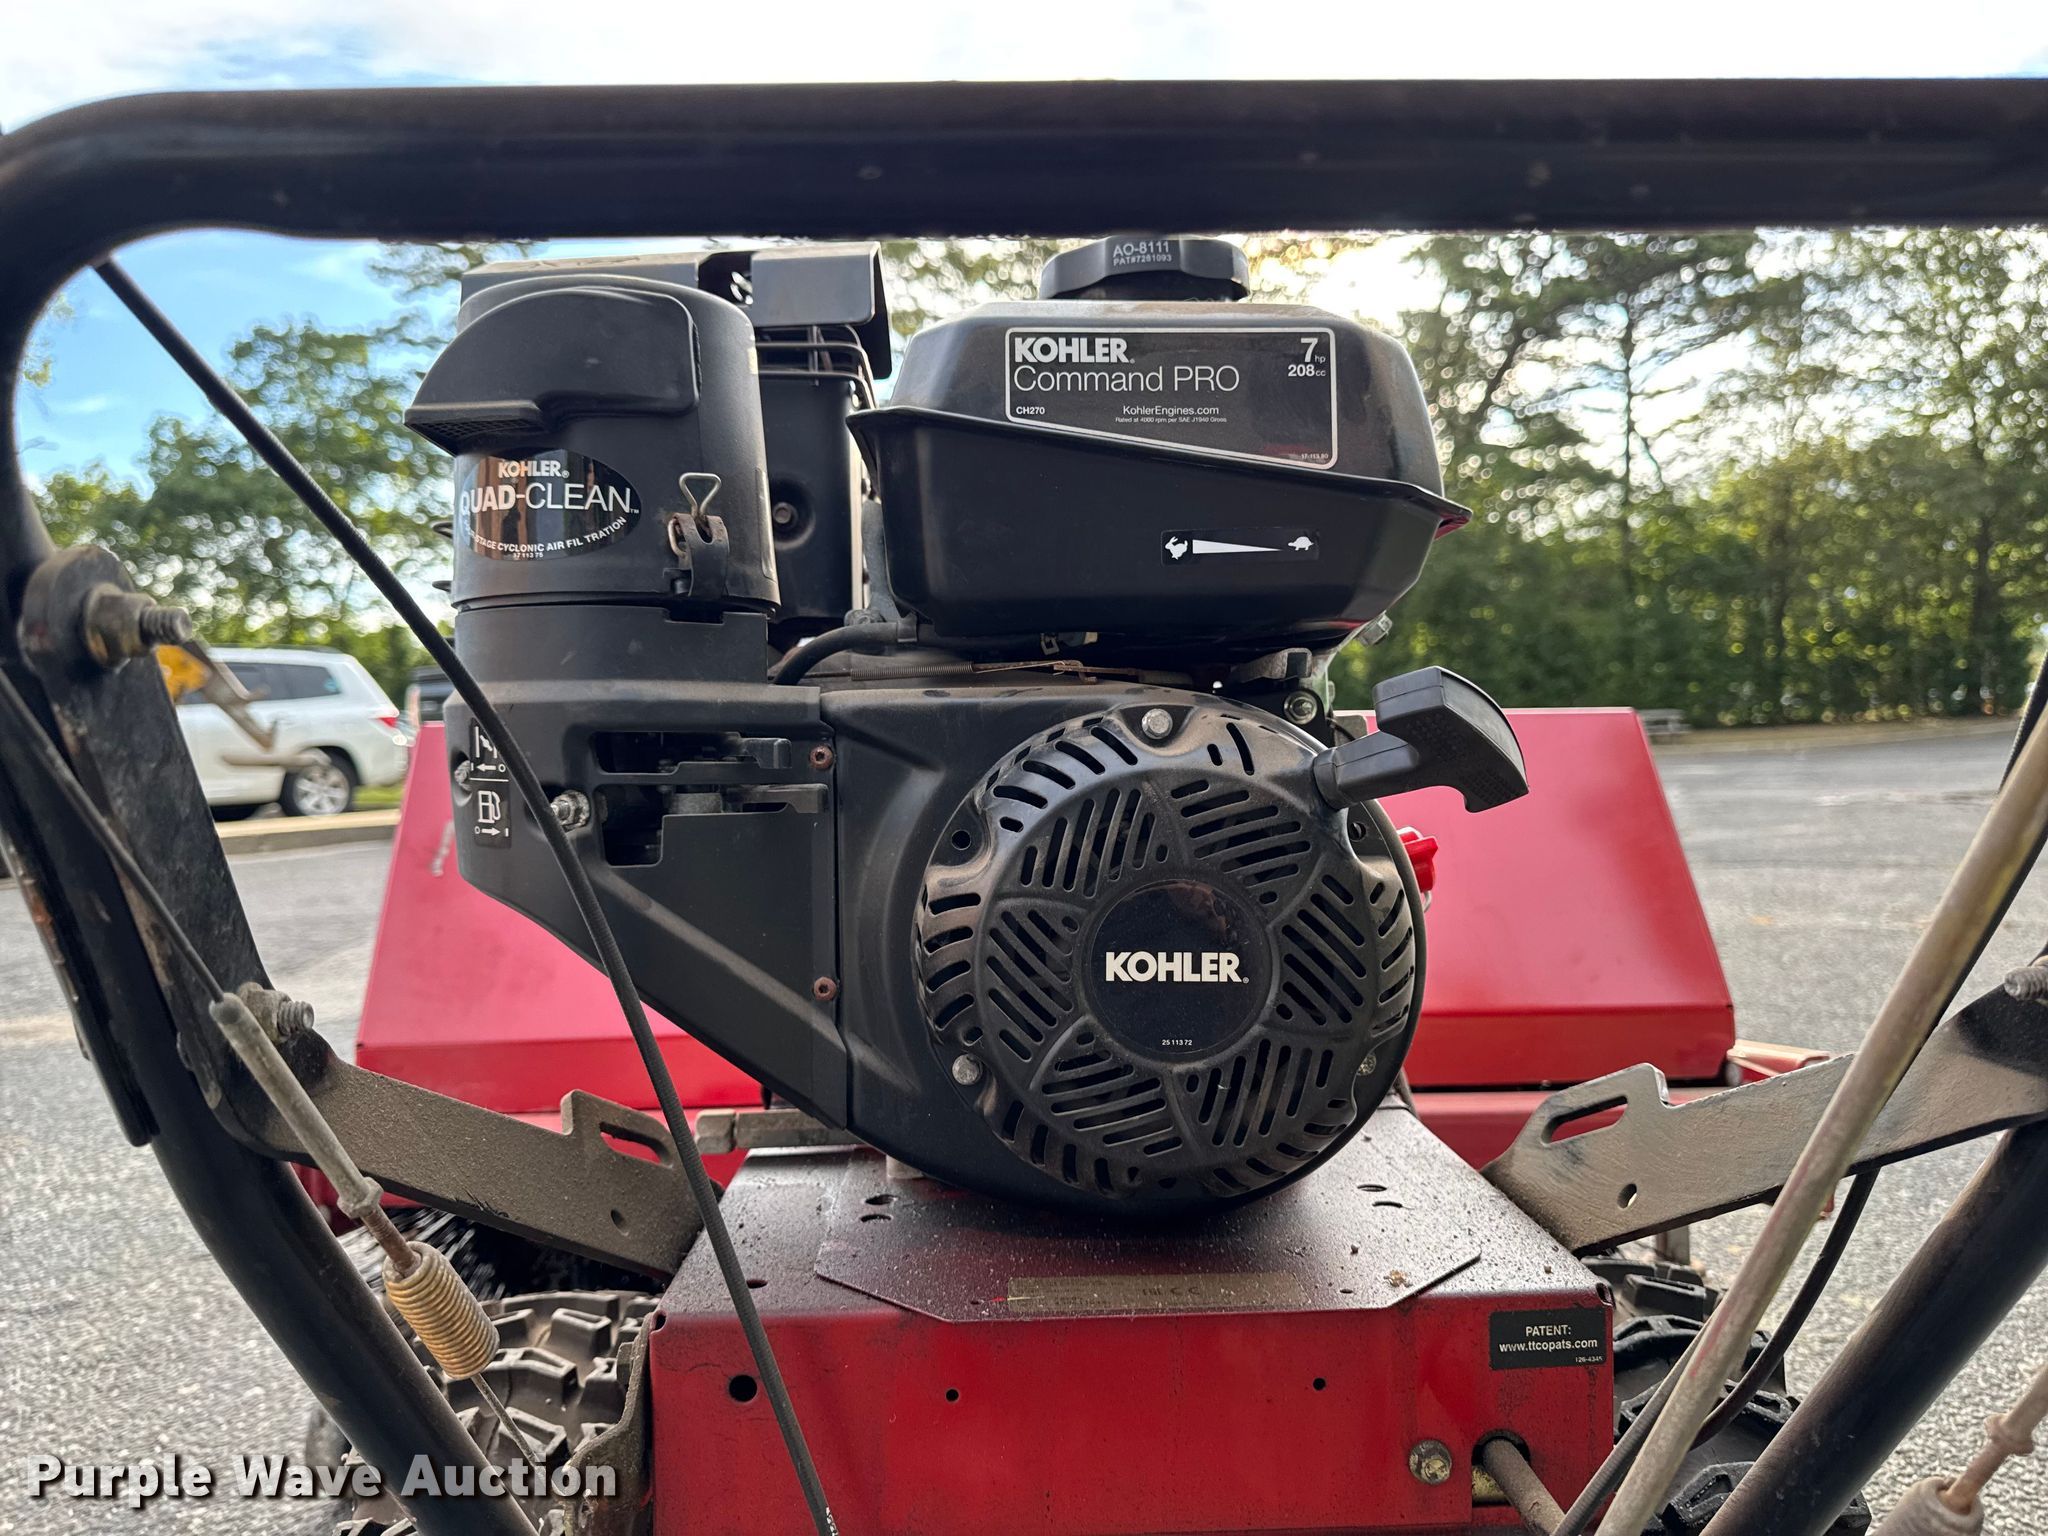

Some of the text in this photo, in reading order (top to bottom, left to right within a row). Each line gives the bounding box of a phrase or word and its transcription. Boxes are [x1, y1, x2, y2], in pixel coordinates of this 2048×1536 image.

[1113, 240, 1170, 258] AO-8111
[1014, 336, 1130, 363] KOHLER
[1014, 365, 1240, 391] Command PRO
[1016, 406, 1046, 415] CH270
[1123, 405, 1219, 417] KohlerEngines.com
[498, 460, 562, 478] KOHLER
[497, 542, 545, 552] CYCLONIC
[546, 540, 565, 551] AIR
[1106, 951, 1242, 982] KOHLER
[1525, 1324, 1572, 1336] PATENT:
[1499, 1339, 1598, 1352] www.ttcopats.com
